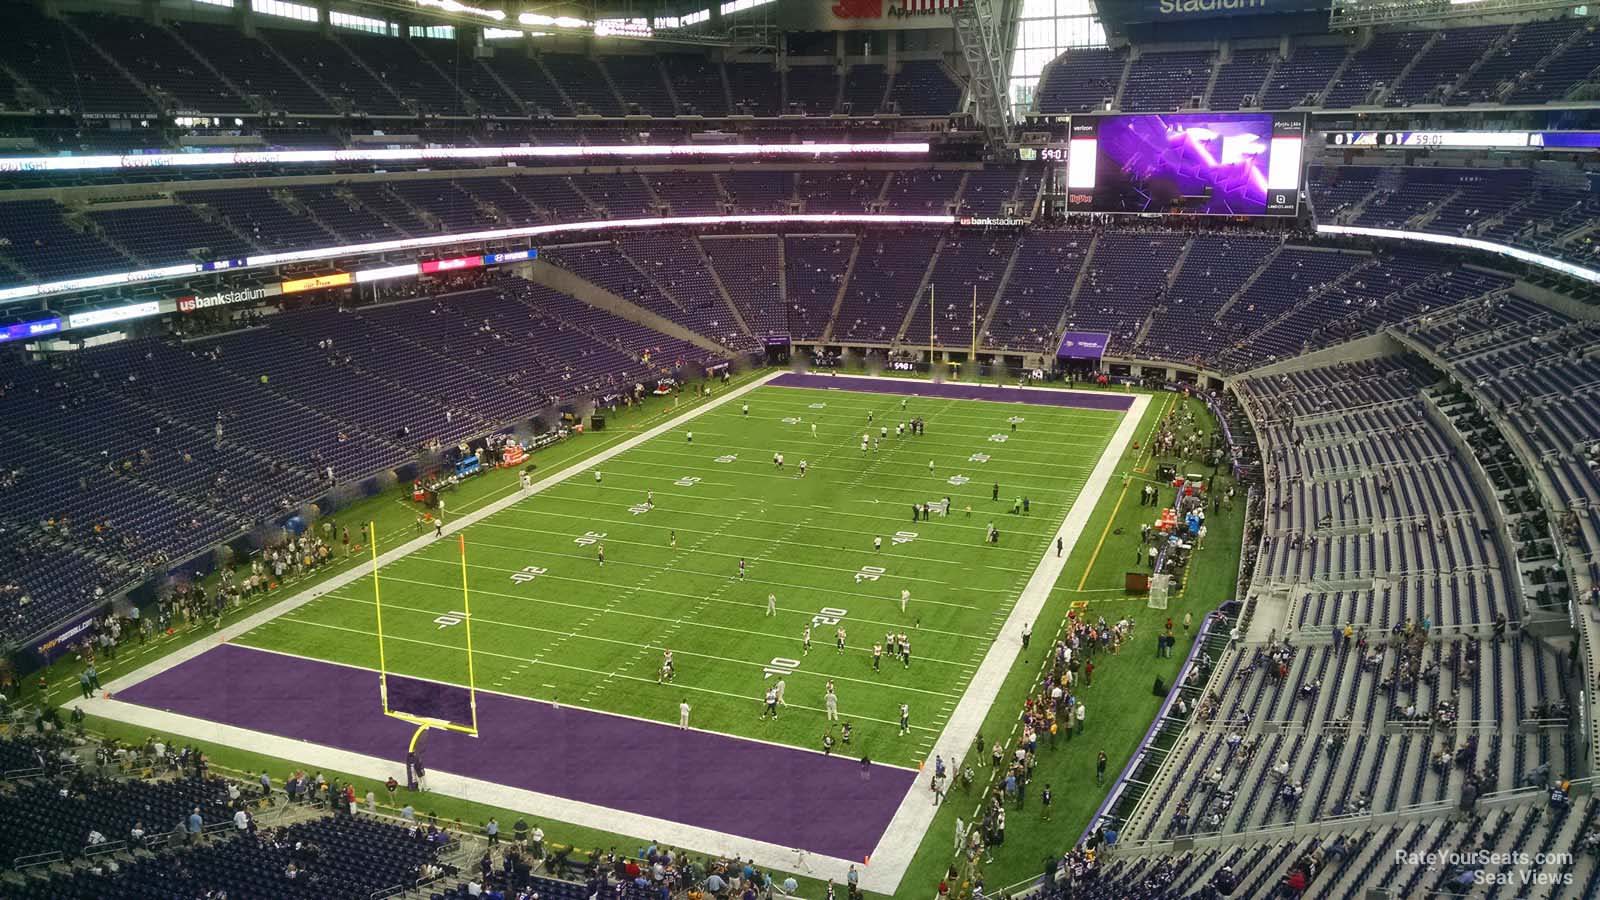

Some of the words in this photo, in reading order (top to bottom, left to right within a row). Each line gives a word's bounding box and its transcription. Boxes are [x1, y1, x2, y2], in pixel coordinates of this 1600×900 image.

[1416, 134, 1443, 145] 59:01
[1041, 149, 1067, 160] 59:01
[510, 566, 548, 582] 20
[811, 607, 848, 626] 20
[763, 657, 801, 676] 10
